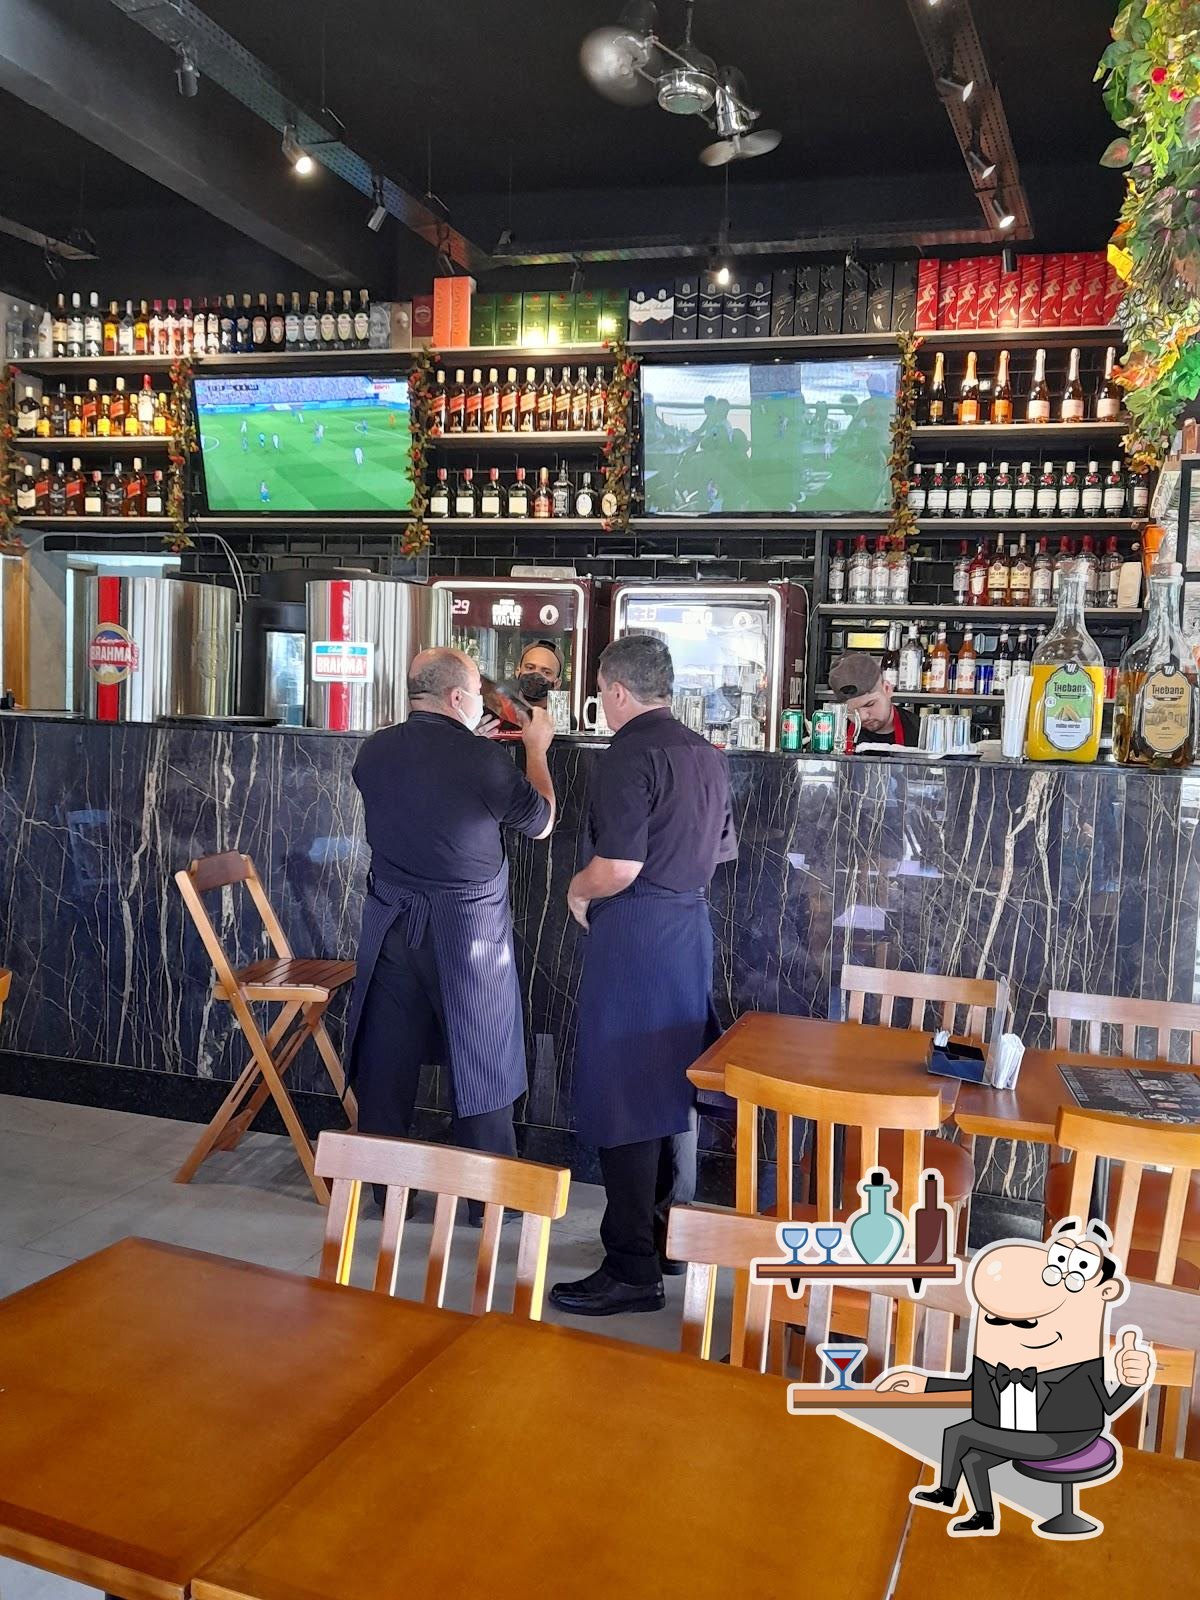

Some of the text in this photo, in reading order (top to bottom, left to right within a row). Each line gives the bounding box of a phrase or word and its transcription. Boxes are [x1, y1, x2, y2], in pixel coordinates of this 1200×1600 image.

[492, 615, 521, 627] MALTE
[90, 645, 132, 662] BRAHMA
[316, 656, 365, 675] BRAHMA
